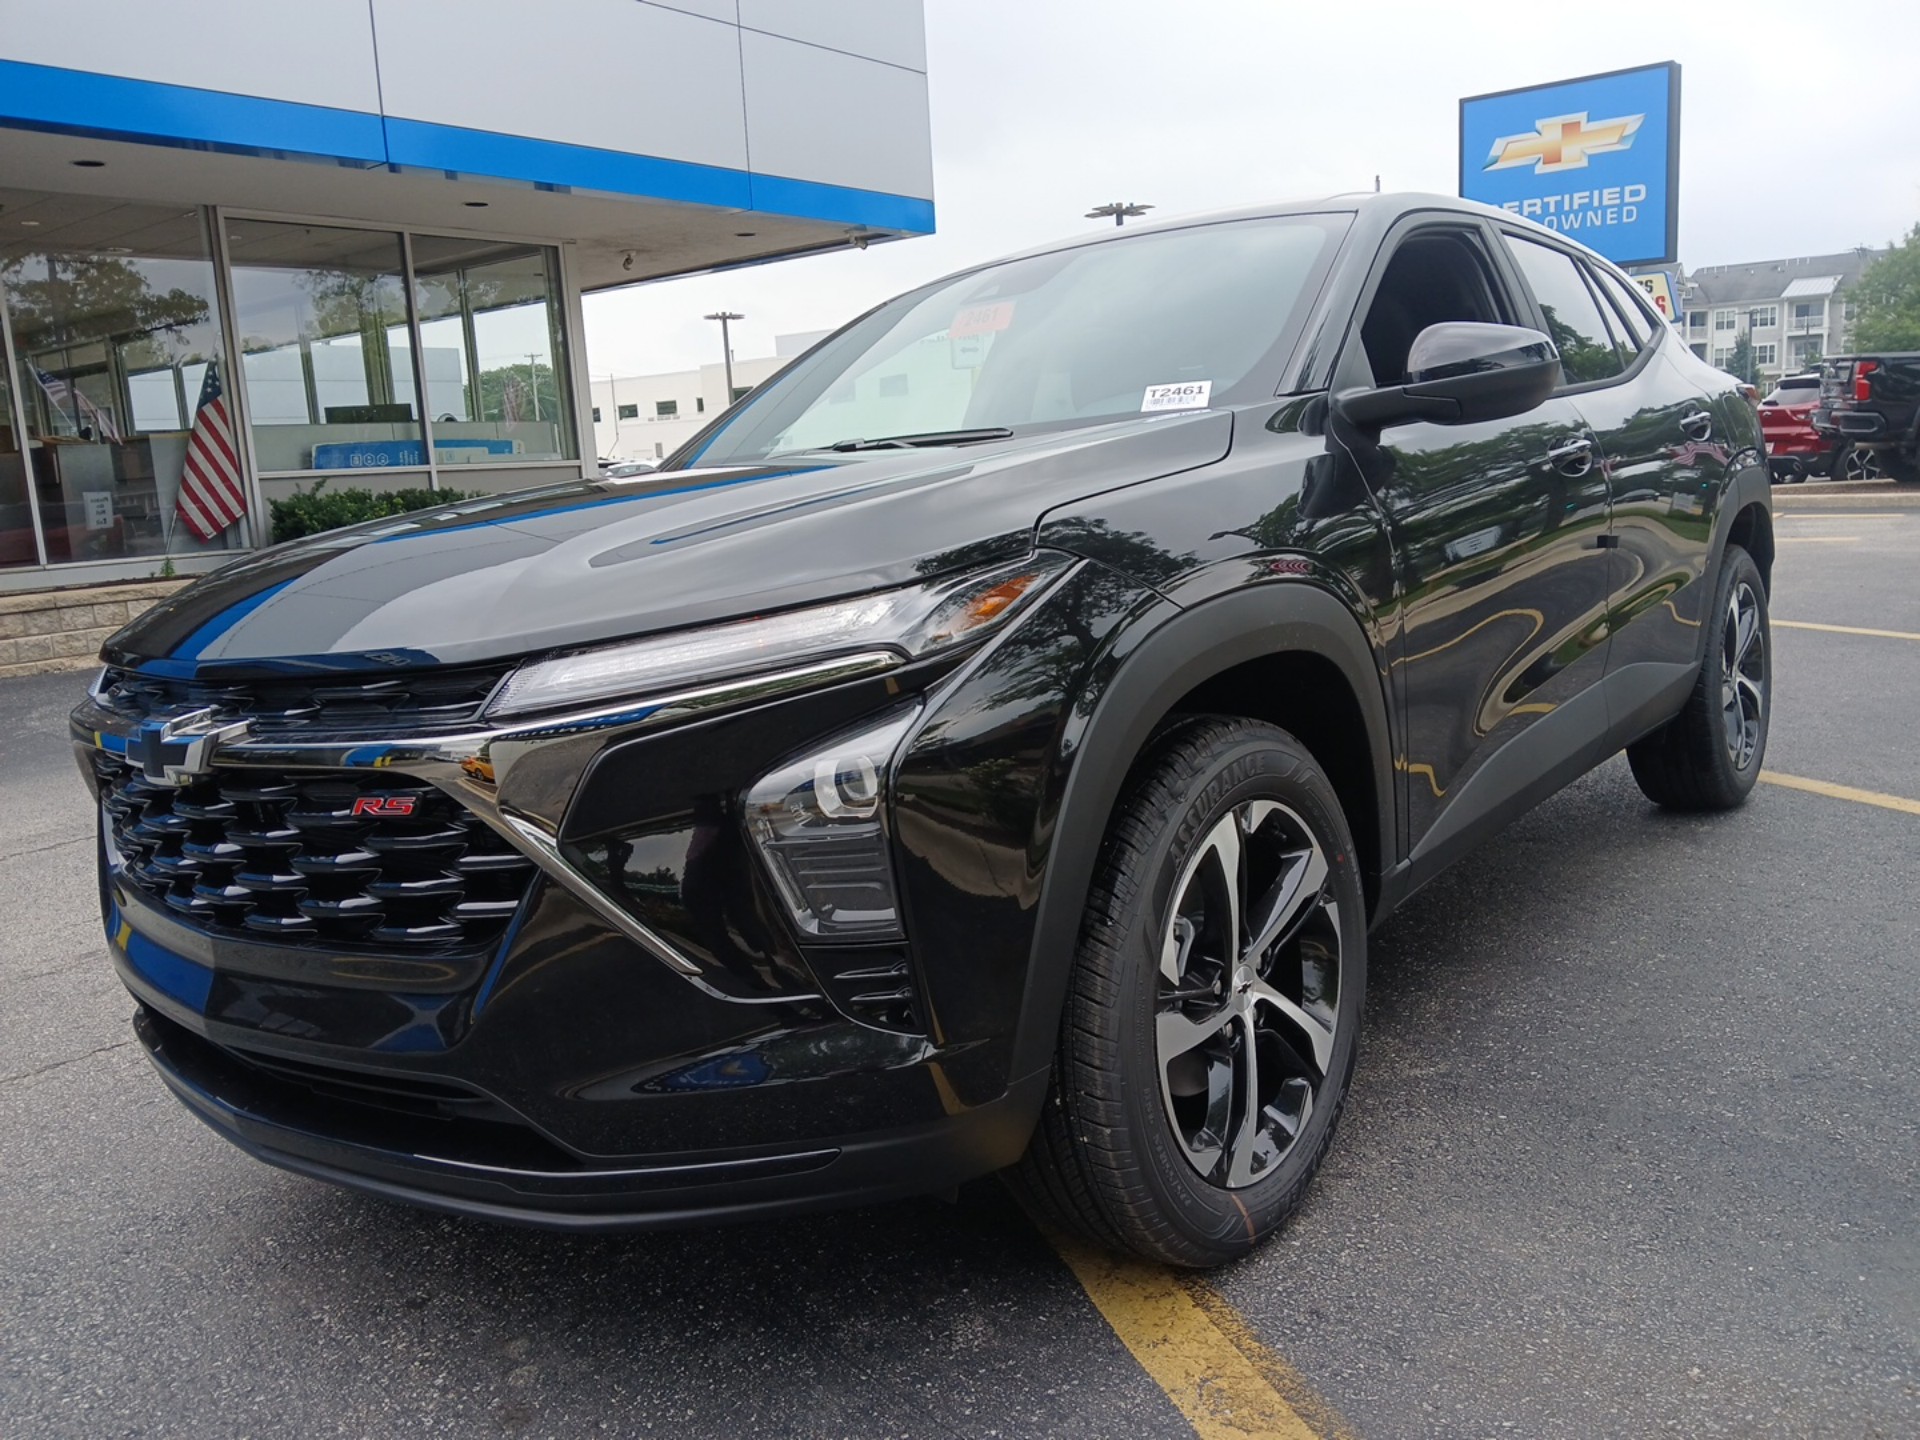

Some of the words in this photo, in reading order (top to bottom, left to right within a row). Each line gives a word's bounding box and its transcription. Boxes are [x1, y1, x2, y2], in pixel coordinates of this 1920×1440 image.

[1492, 183, 1647, 217] ERTIFIED
[1149, 385, 1205, 398] T2461
[351, 797, 416, 816] RS
[1170, 754, 1266, 869] ASSURANCE
